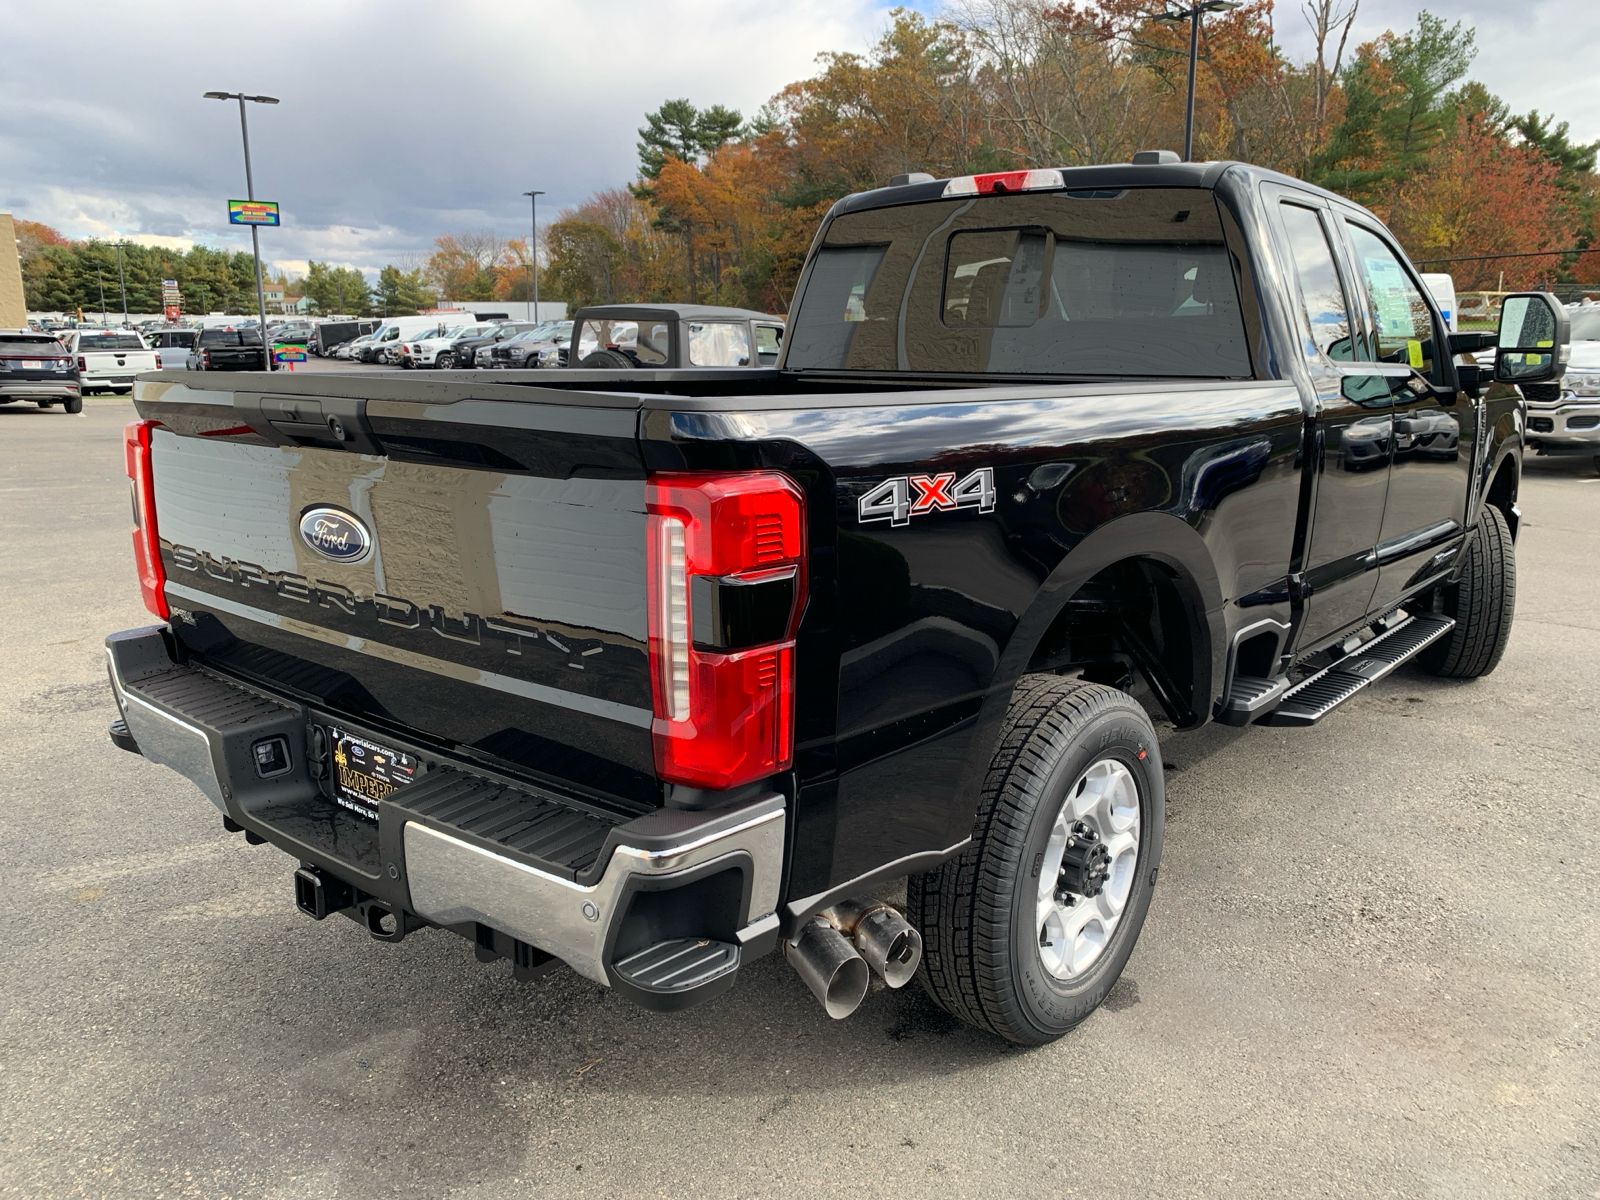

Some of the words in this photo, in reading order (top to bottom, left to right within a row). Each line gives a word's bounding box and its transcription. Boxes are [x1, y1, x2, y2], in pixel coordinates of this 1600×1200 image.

[312, 519, 349, 551] Ford
[172, 543, 356, 615] SUPER
[374, 593, 604, 670] DUTY
[339, 765, 399, 800] IMPERI
